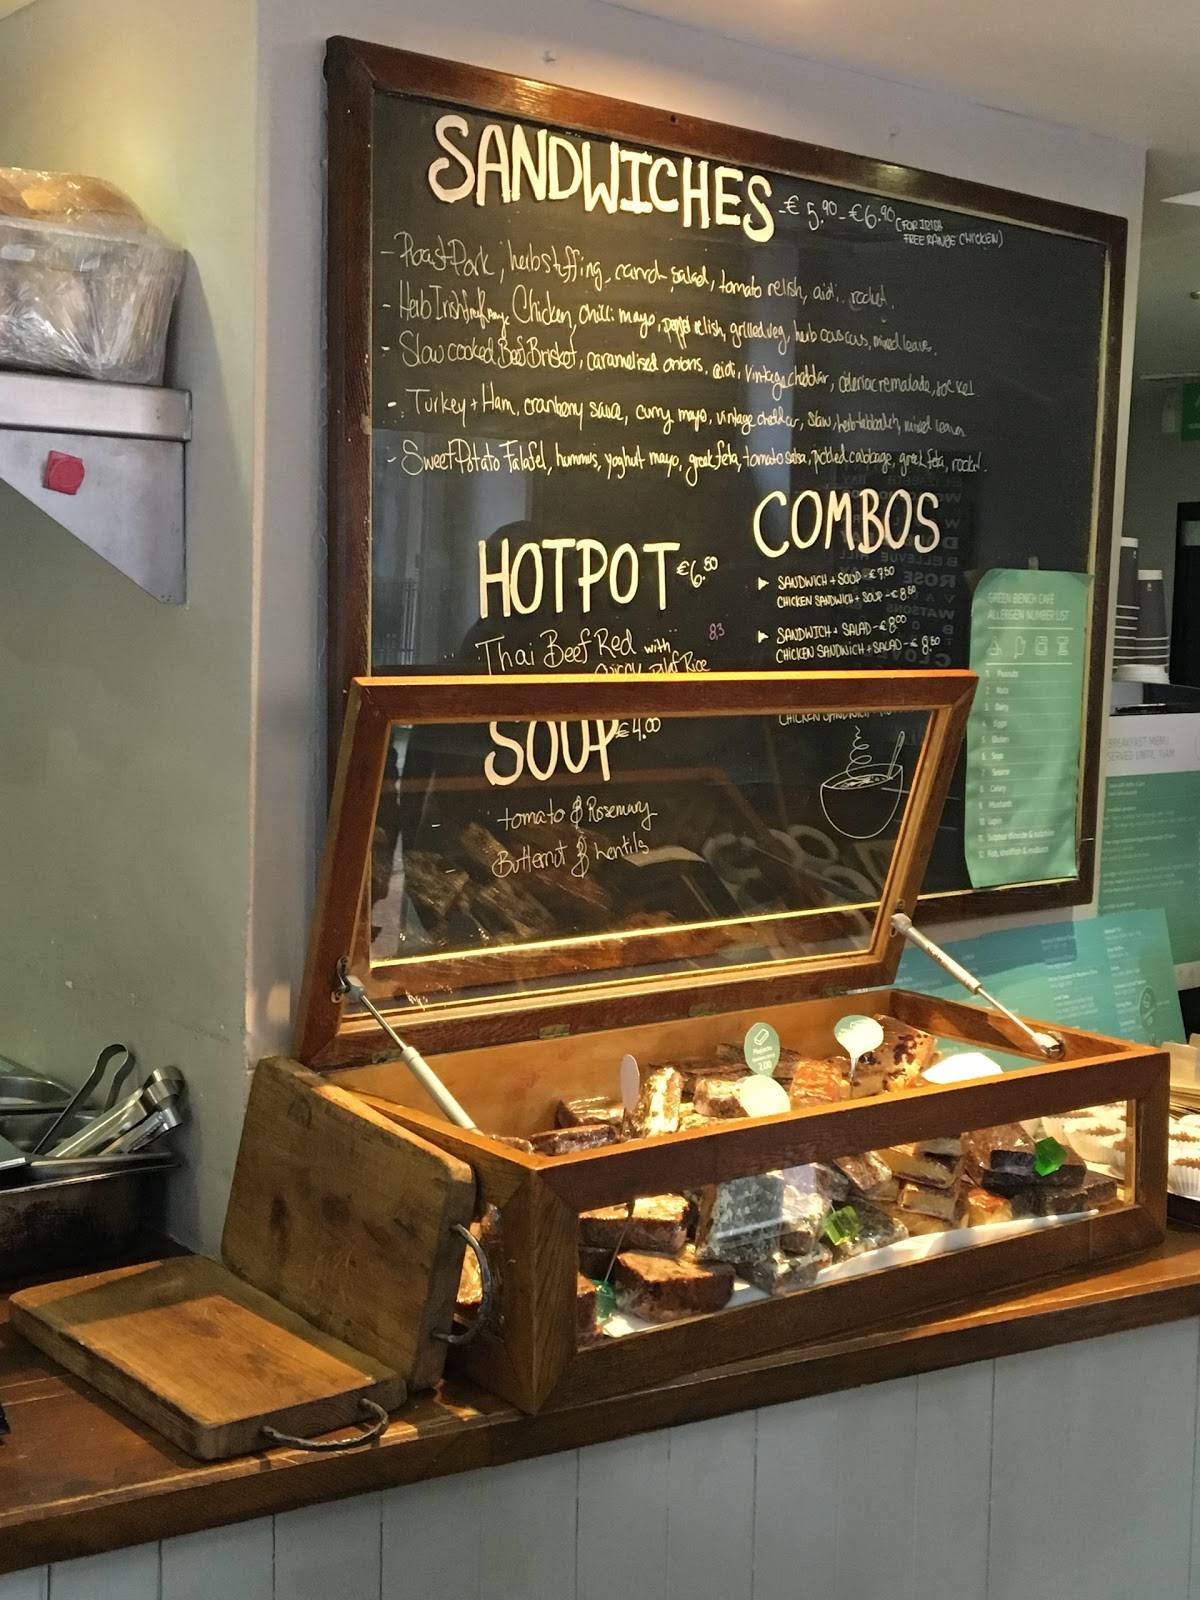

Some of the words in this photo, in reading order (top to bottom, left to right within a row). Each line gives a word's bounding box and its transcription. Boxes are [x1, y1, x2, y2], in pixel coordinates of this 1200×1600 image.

[428, 114, 774, 243] SANDWICHES
[904, 233, 925, 246] FREE
[394, 230, 452, 271] Roast
[507, 240, 541, 272] herb
[719, 269, 762, 298] tomato
[400, 279, 431, 321] Herb
[399, 330, 444, 367] Slow
[447, 337, 497, 364] cooked
[405, 388, 466, 427] Turkey
[742, 445, 783, 467] tomato
[753, 488, 941, 558] COMBOS
[478, 538, 681, 619] HOTPOT
[777, 573, 828, 590] SANDWICH
[838, 571, 862, 585] SOUP
[776, 595, 813, 608] CHICKEN
[814, 593, 854, 608] SANDWICH
[862, 590, 883, 603] SOUP
[475, 636, 535, 675] Thai
[539, 628, 592, 668] Beef
[594, 628, 637, 659] Red
[644, 638, 672, 654] with
[776, 625, 832, 644] SANDWICH
[841, 622, 872, 637] SALAD
[872, 639, 903, 654] SALAD
[680, 651, 711, 672] Rice
[484, 719, 619, 786] SOUP
